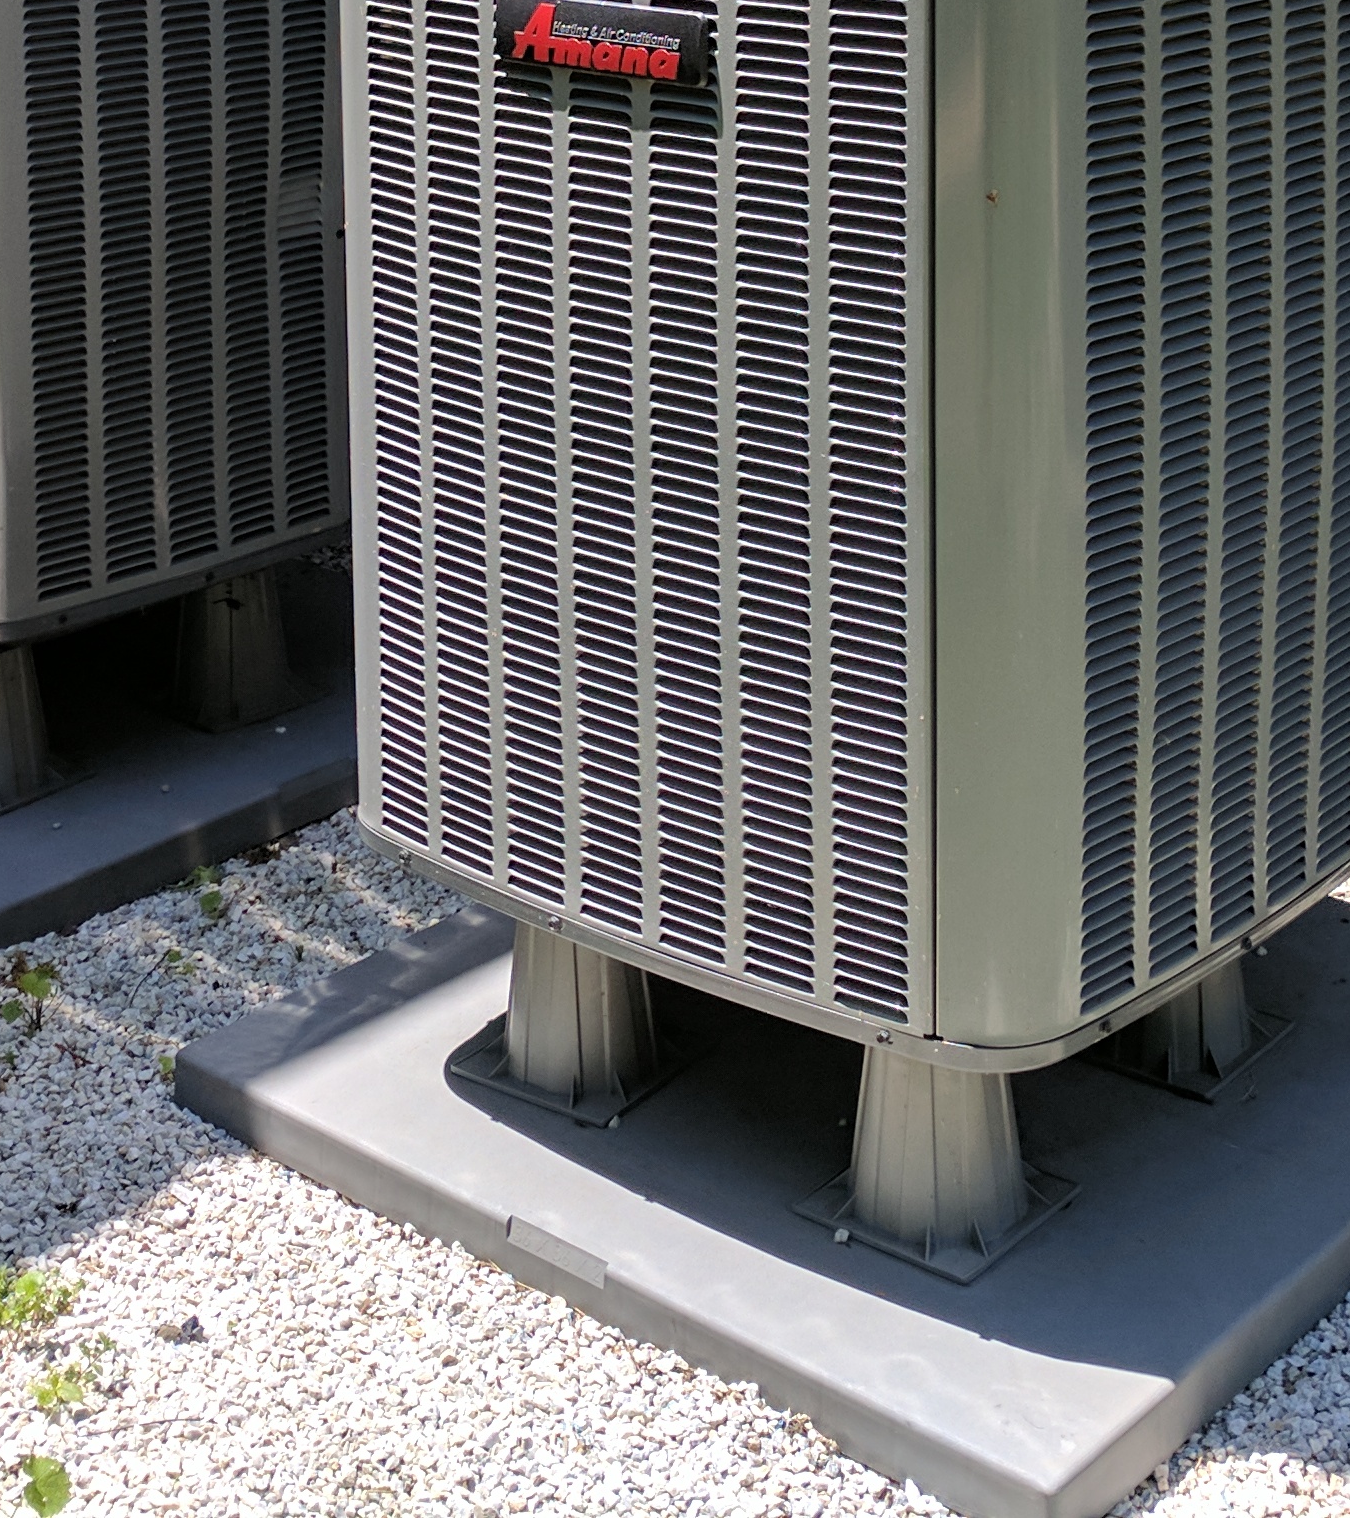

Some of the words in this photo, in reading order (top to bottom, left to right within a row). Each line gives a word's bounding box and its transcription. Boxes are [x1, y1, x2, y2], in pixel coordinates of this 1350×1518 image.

[512, 2, 681, 80] Amana
[552, 20, 589, 39] Heating
[616, 28, 681, 50] Conditioning
